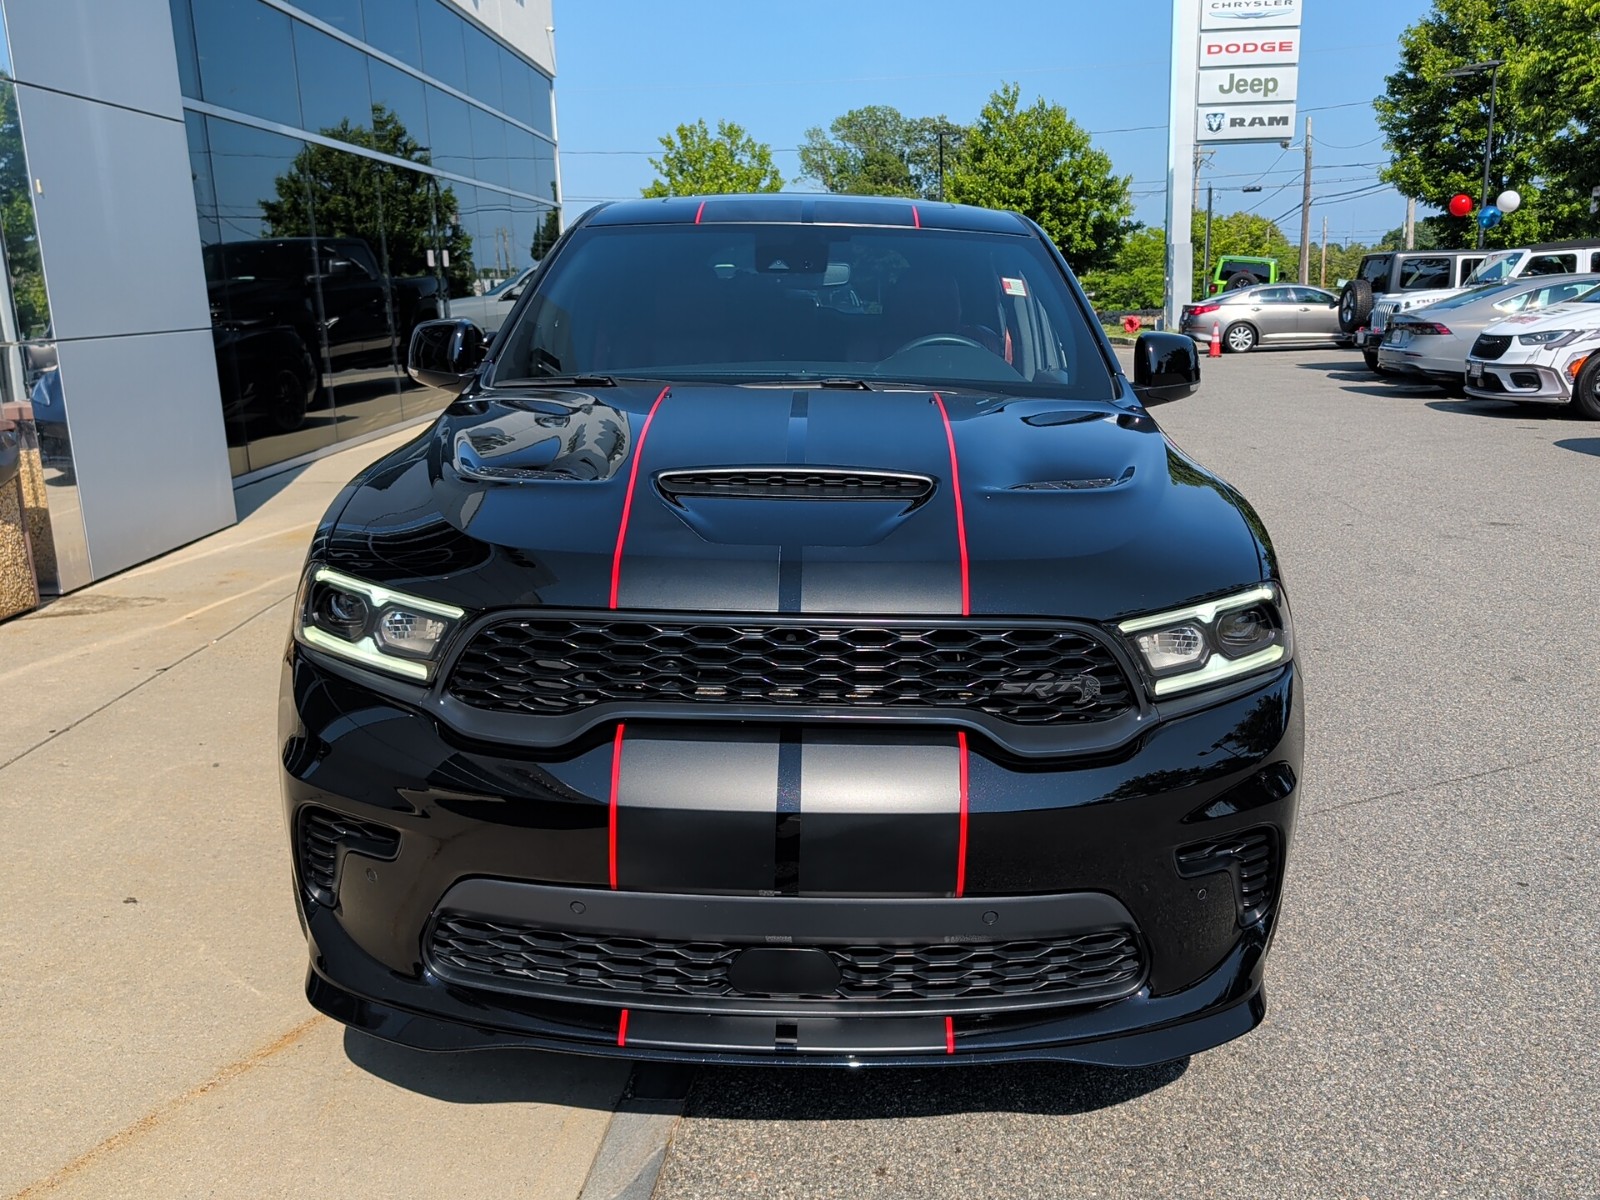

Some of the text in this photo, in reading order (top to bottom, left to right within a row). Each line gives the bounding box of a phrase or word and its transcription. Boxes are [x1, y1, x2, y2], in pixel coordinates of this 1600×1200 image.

[1211, 0, 1293, 9] CHRYSLER
[1207, 41, 1293, 55] DODGE
[1218, 73, 1278, 97] Jeep
[1229, 116, 1289, 128] RAM
[994, 681, 1081, 698] SRT
